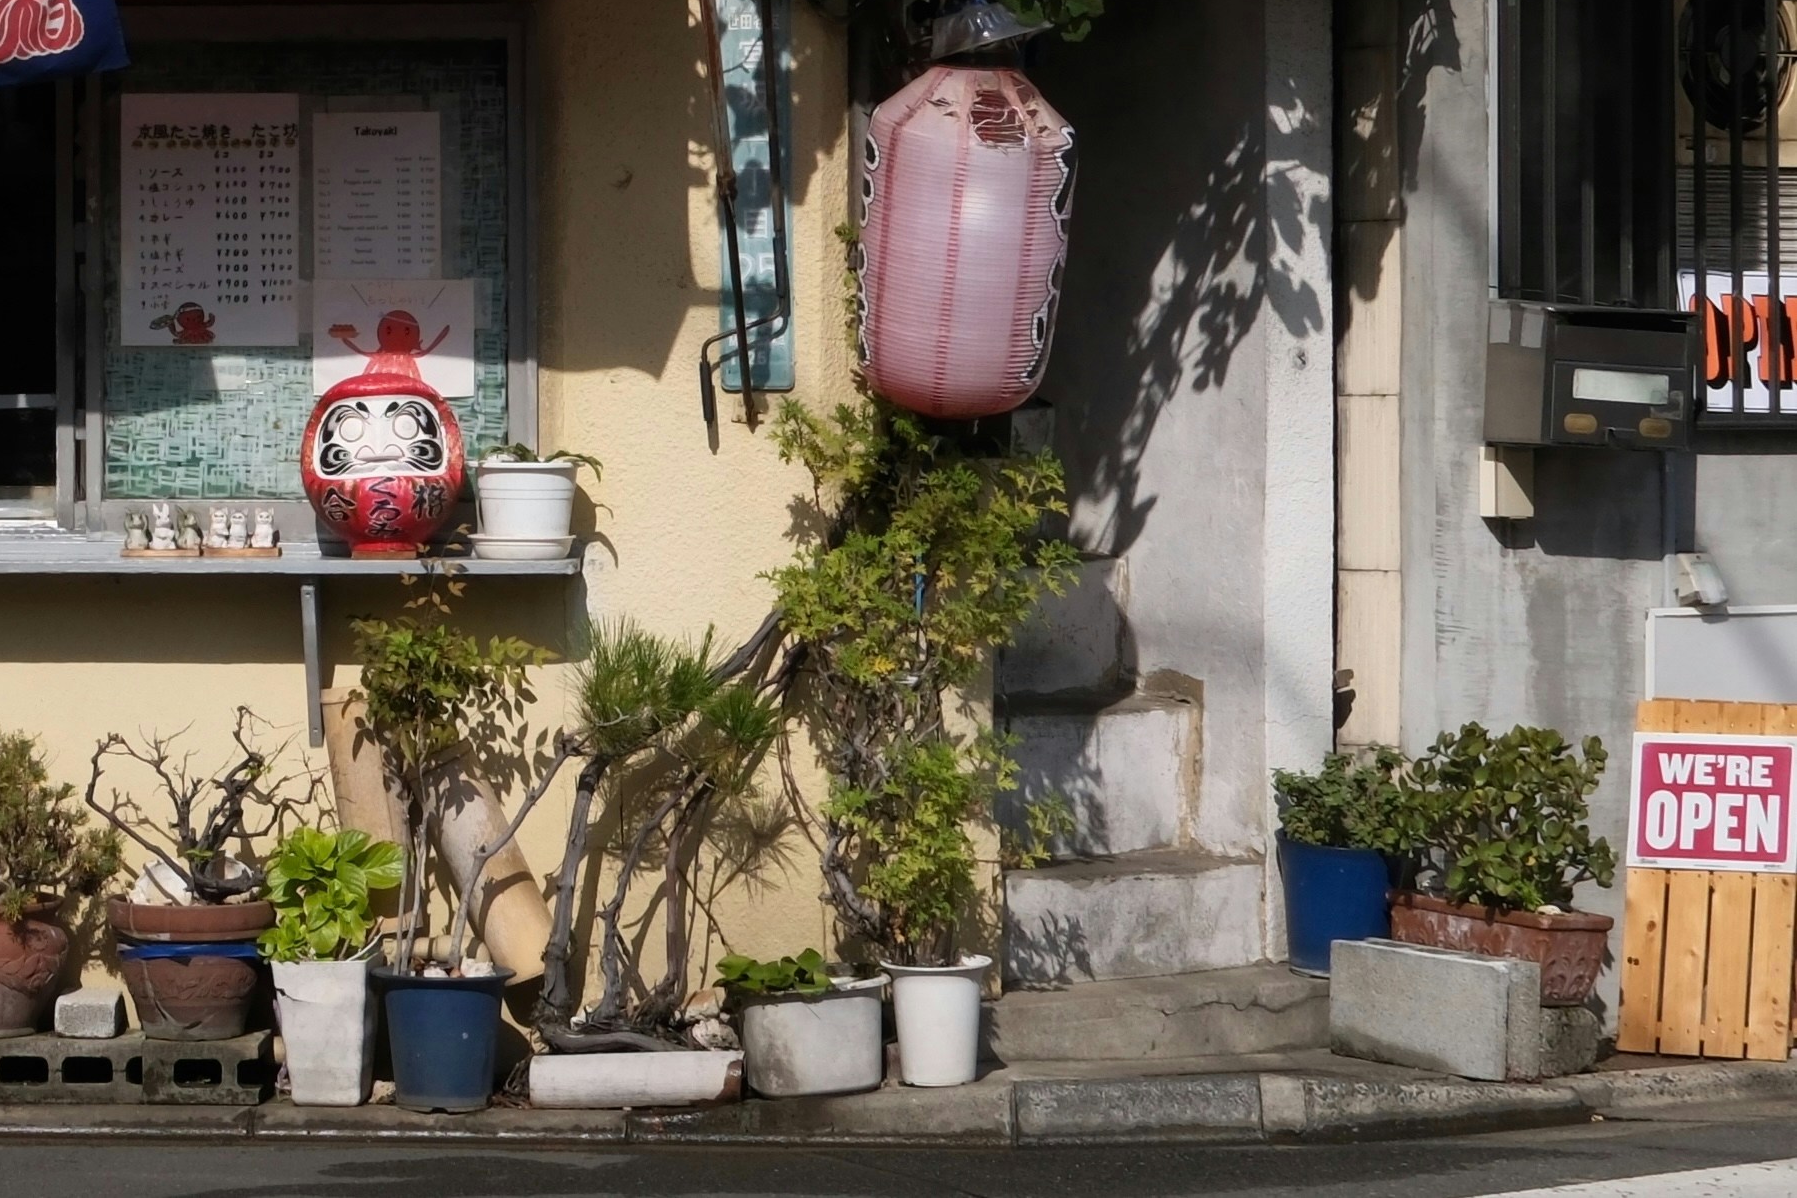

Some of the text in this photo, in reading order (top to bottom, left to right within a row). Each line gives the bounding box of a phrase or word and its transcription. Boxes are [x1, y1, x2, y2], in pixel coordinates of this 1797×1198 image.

[138, 123, 299, 140] 京風たこ焼き たこ坊
[149, 168, 184, 178] ソース
[148, 183, 206, 192] 塩コショウ
[215, 211, 248, 220] ¥600
[151, 264, 184, 275] チーズ
[150, 281, 211, 290] スペシャル
[217, 278, 249, 288] ¥900
[217, 295, 249, 304] ¥700
[322, 485, 357, 522] 合
[1658, 753, 1774, 788] WE'RE
[1645, 790, 1781, 854] OPEN
